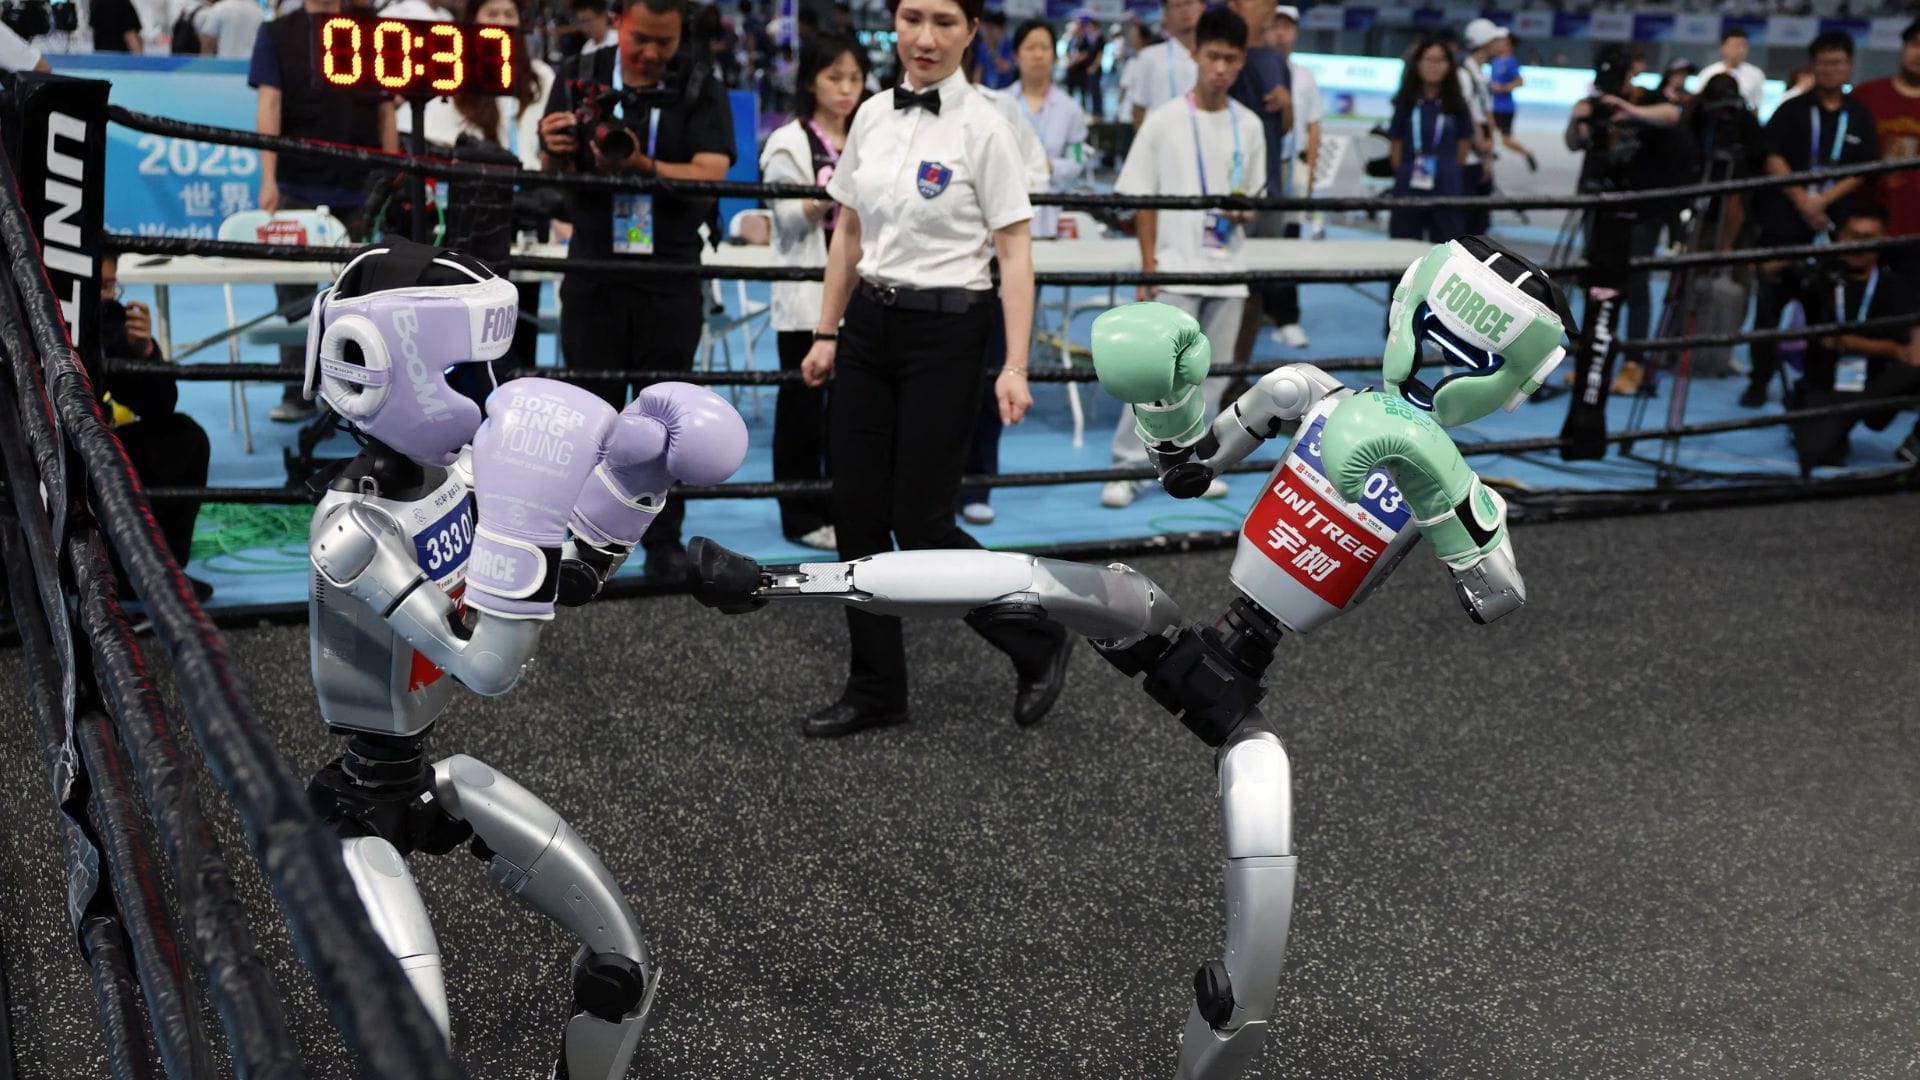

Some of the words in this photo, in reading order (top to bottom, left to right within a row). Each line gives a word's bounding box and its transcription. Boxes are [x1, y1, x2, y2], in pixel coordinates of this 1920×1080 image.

[323, 18, 512, 90] 00:37
[137, 136, 259, 176] 2025
[179, 182, 254, 217] 世界
[480, 304, 518, 343] FOR
[1436, 272, 1515, 343] FORCE
[511, 395, 586, 427] BOXER
[501, 420, 574, 466] YOUNG
[1272, 479, 1378, 564] UNITREE
[471, 545, 518, 583] ORCE
[1267, 518, 1341, 582] 宇树
